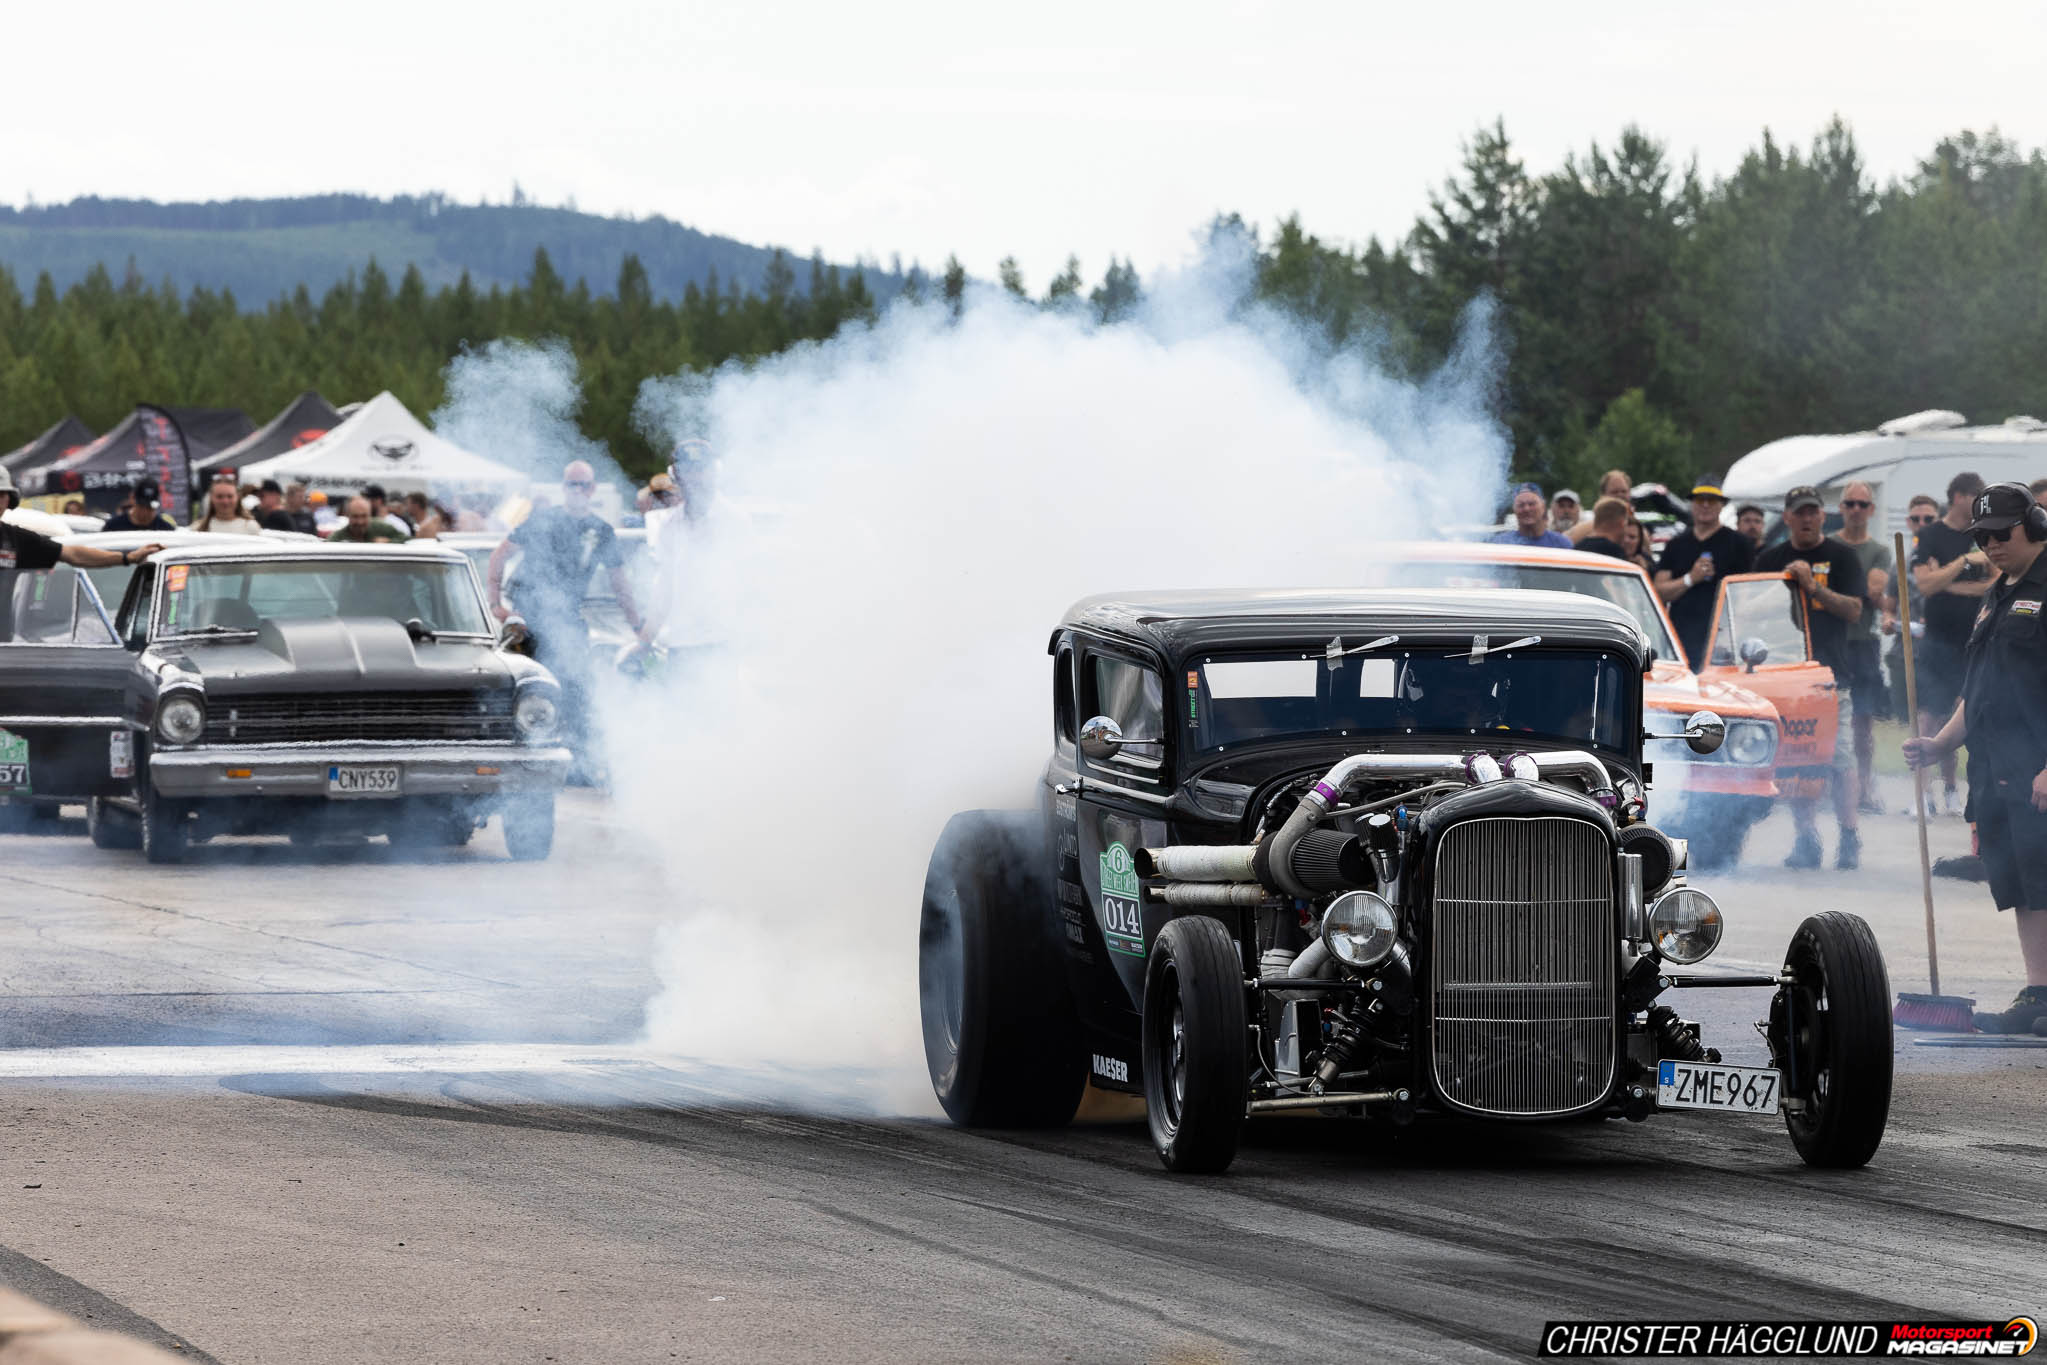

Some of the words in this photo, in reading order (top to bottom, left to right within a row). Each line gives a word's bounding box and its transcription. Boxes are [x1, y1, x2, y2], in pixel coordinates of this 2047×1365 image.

[338, 769, 397, 789] CNY539
[1114, 849, 1123, 872] 6
[1105, 897, 1140, 935] 014
[1093, 1053, 1128, 1083] KAESER
[1675, 1068, 1776, 1109] ZME967
